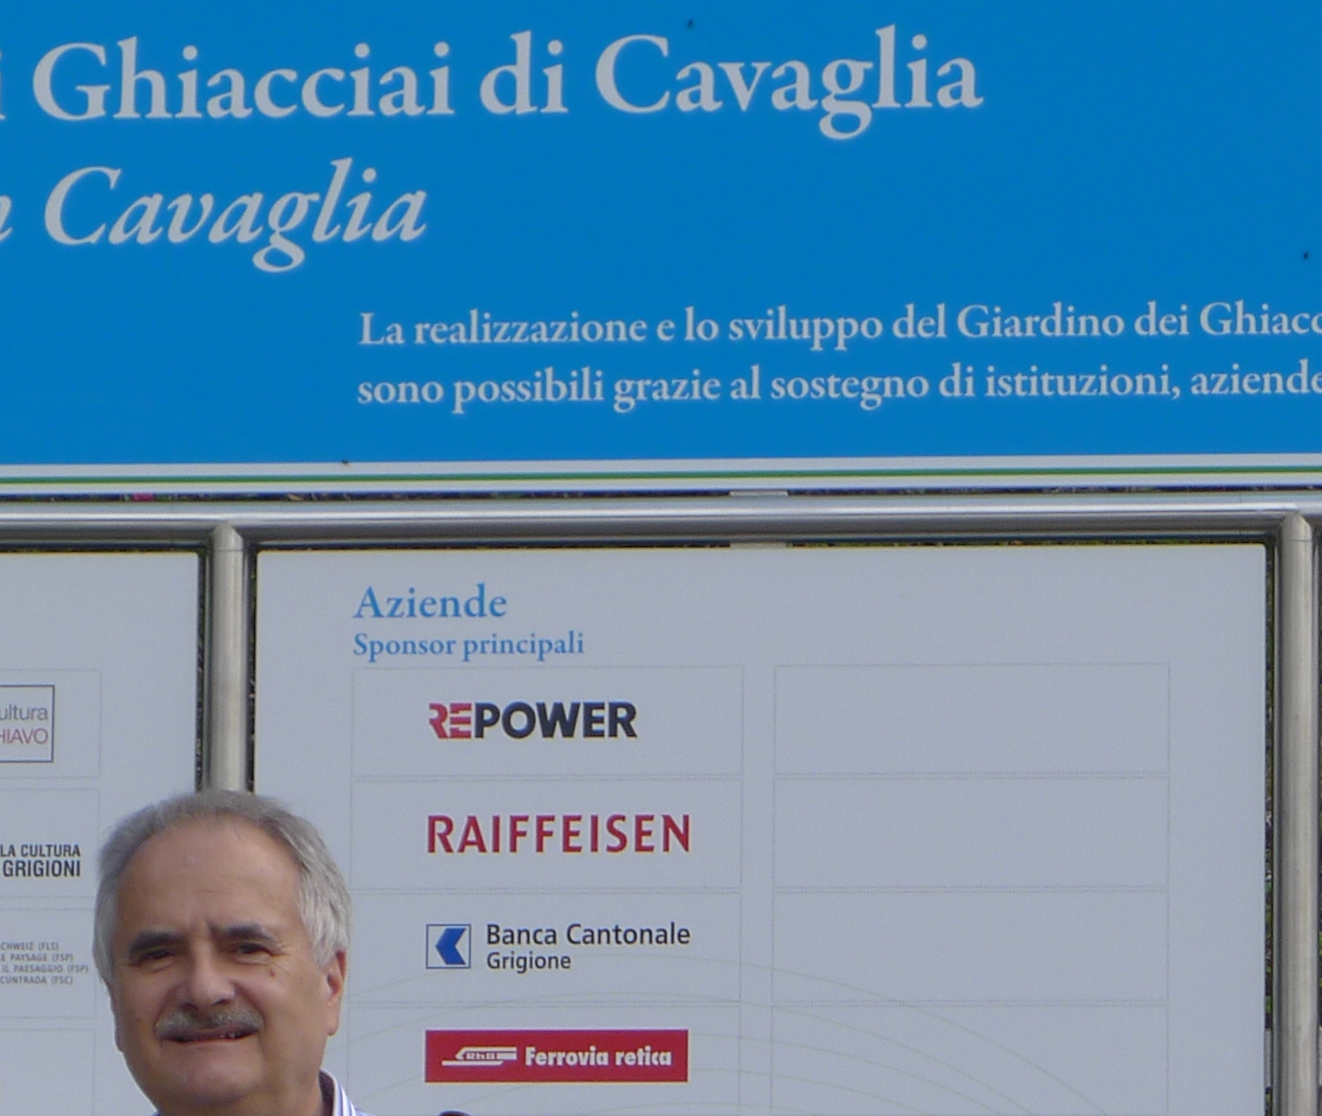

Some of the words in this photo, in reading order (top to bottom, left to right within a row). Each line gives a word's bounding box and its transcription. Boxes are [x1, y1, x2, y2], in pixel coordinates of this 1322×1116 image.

[33, 36, 454, 121] Ghiacciai
[480, 30, 568, 115] di
[596, 24, 984, 140] Cavaglia
[44, 157, 426, 273] Cavaglia
[360, 313, 405, 345] La
[415, 309, 647, 344] realizzazione
[657, 320, 675, 341] e
[685, 306, 719, 341] lo
[729, 305, 883, 351] sviluppo
[892, 303, 946, 338] del
[957, 301, 1125, 338] Giardino
[1134, 301, 1189, 336] dei
[358, 382, 444, 403] sono
[453, 366, 604, 414] possibili
[613, 369, 721, 413] grazie
[730, 364, 760, 399] al
[771, 375, 929, 410] sostegno
[939, 362, 975, 397] di
[986, 364, 1180, 399] istituzioni,
[355, 583, 506, 618] Aziende
[354, 634, 456, 663] Sponsor
[463, 630, 583, 662] principali
[428, 701, 637, 739] REPOWER
[21, 844, 80, 858] CULTURA
[427, 814, 690, 853] RAIFFEISEN
[3, 860, 80, 877] GRIGIONI
[487, 924, 557, 945] Banca
[567, 922, 690, 945] Cantonale
[487, 951, 571, 974] Grigione
[525, 1046, 608, 1066] Ferrovia
[616, 1046, 672, 1066] retica
